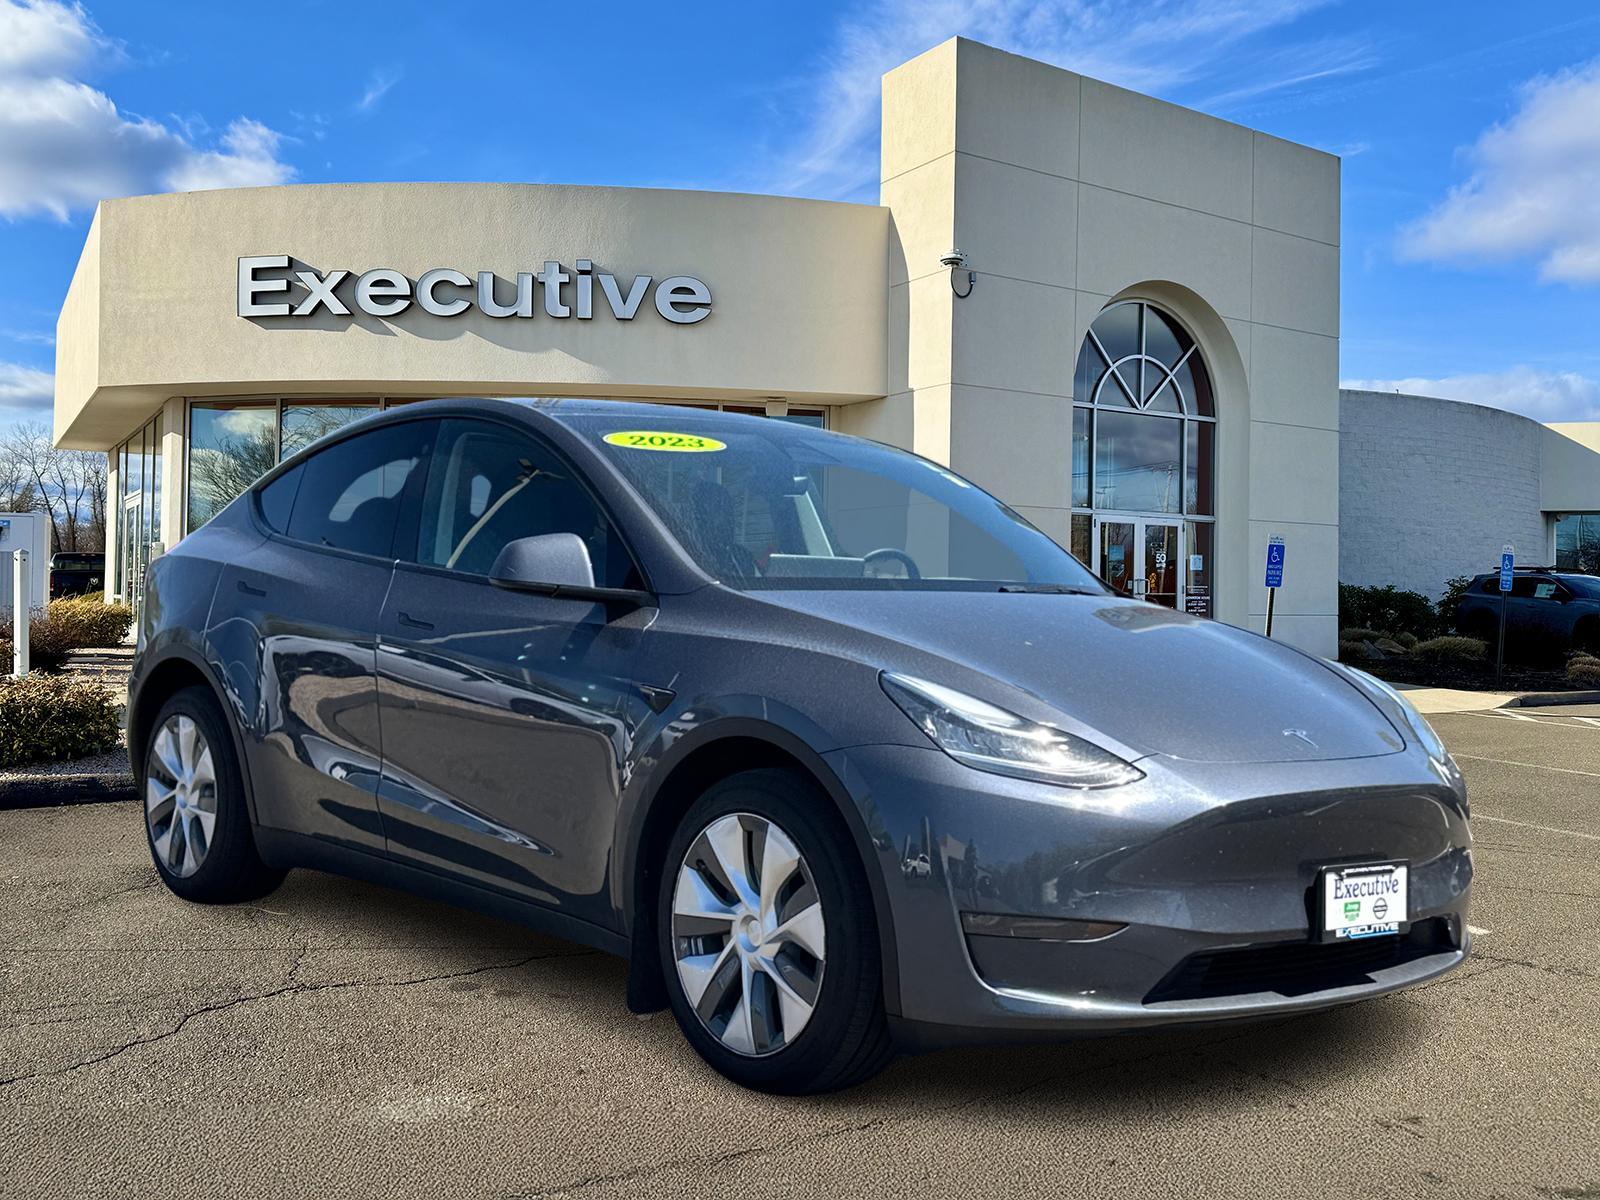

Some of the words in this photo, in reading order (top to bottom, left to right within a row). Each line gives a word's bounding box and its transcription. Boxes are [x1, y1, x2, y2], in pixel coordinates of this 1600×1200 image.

[236, 254, 713, 324] Executive
[629, 436, 704, 448] 2023
[1333, 874, 1399, 900] Executive
[1335, 921, 1399, 938] EXECUTIVE
